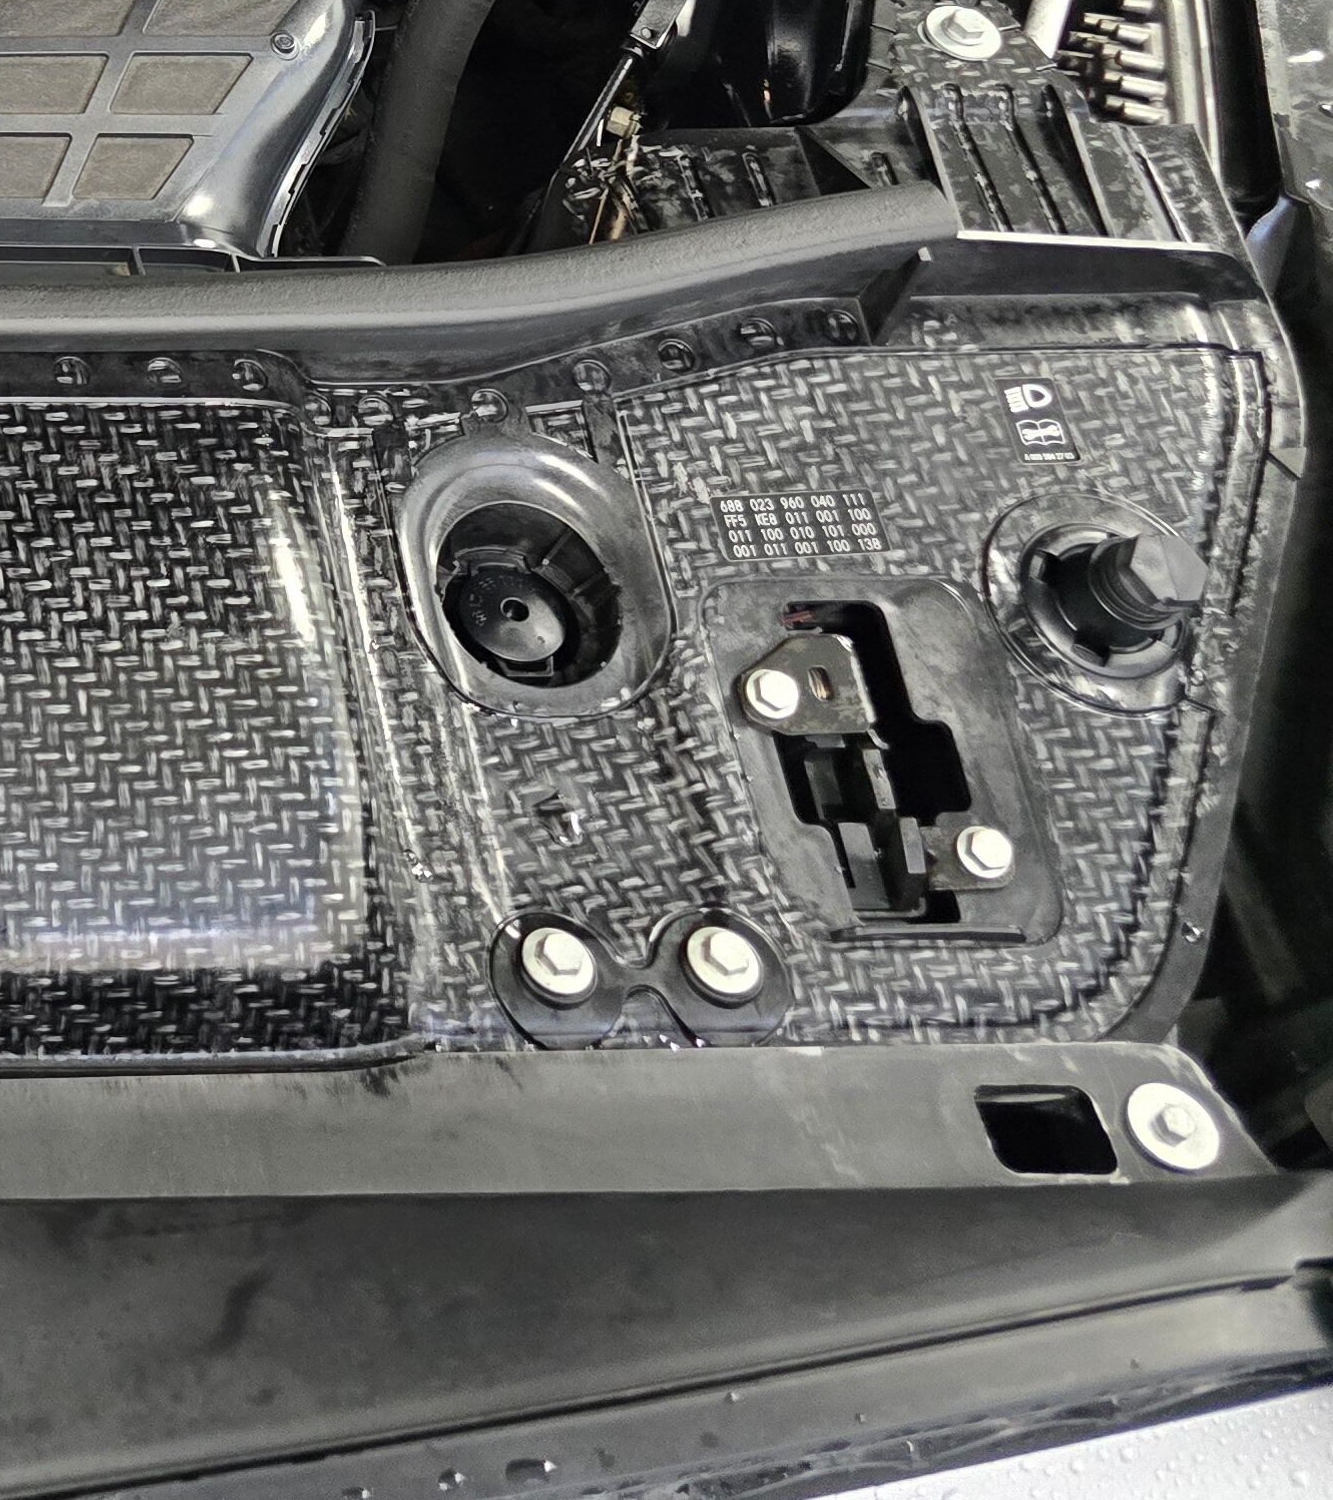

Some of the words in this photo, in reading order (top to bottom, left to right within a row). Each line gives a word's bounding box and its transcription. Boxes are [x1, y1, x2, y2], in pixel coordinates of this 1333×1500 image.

[749, 497, 775, 511] 023
[779, 496, 805, 509] 960
[810, 494, 836, 508] 040
[842, 493, 866, 506] 111
[725, 514, 748, 528] FF5
[785, 511, 810, 525] 011
[815, 509, 840, 523] 001
[847, 508, 871, 521] 100
[728, 529, 752, 543] 011
[760, 527, 784, 541] 100
[790, 526, 815, 540] 010
[822, 524, 845, 538] 101
[851, 522, 877, 536] 000
[733, 544, 757, 558] 001
[764, 543, 788, 556] 011
[794, 541, 819, 555] 001
[827, 539, 850, 553] 100
